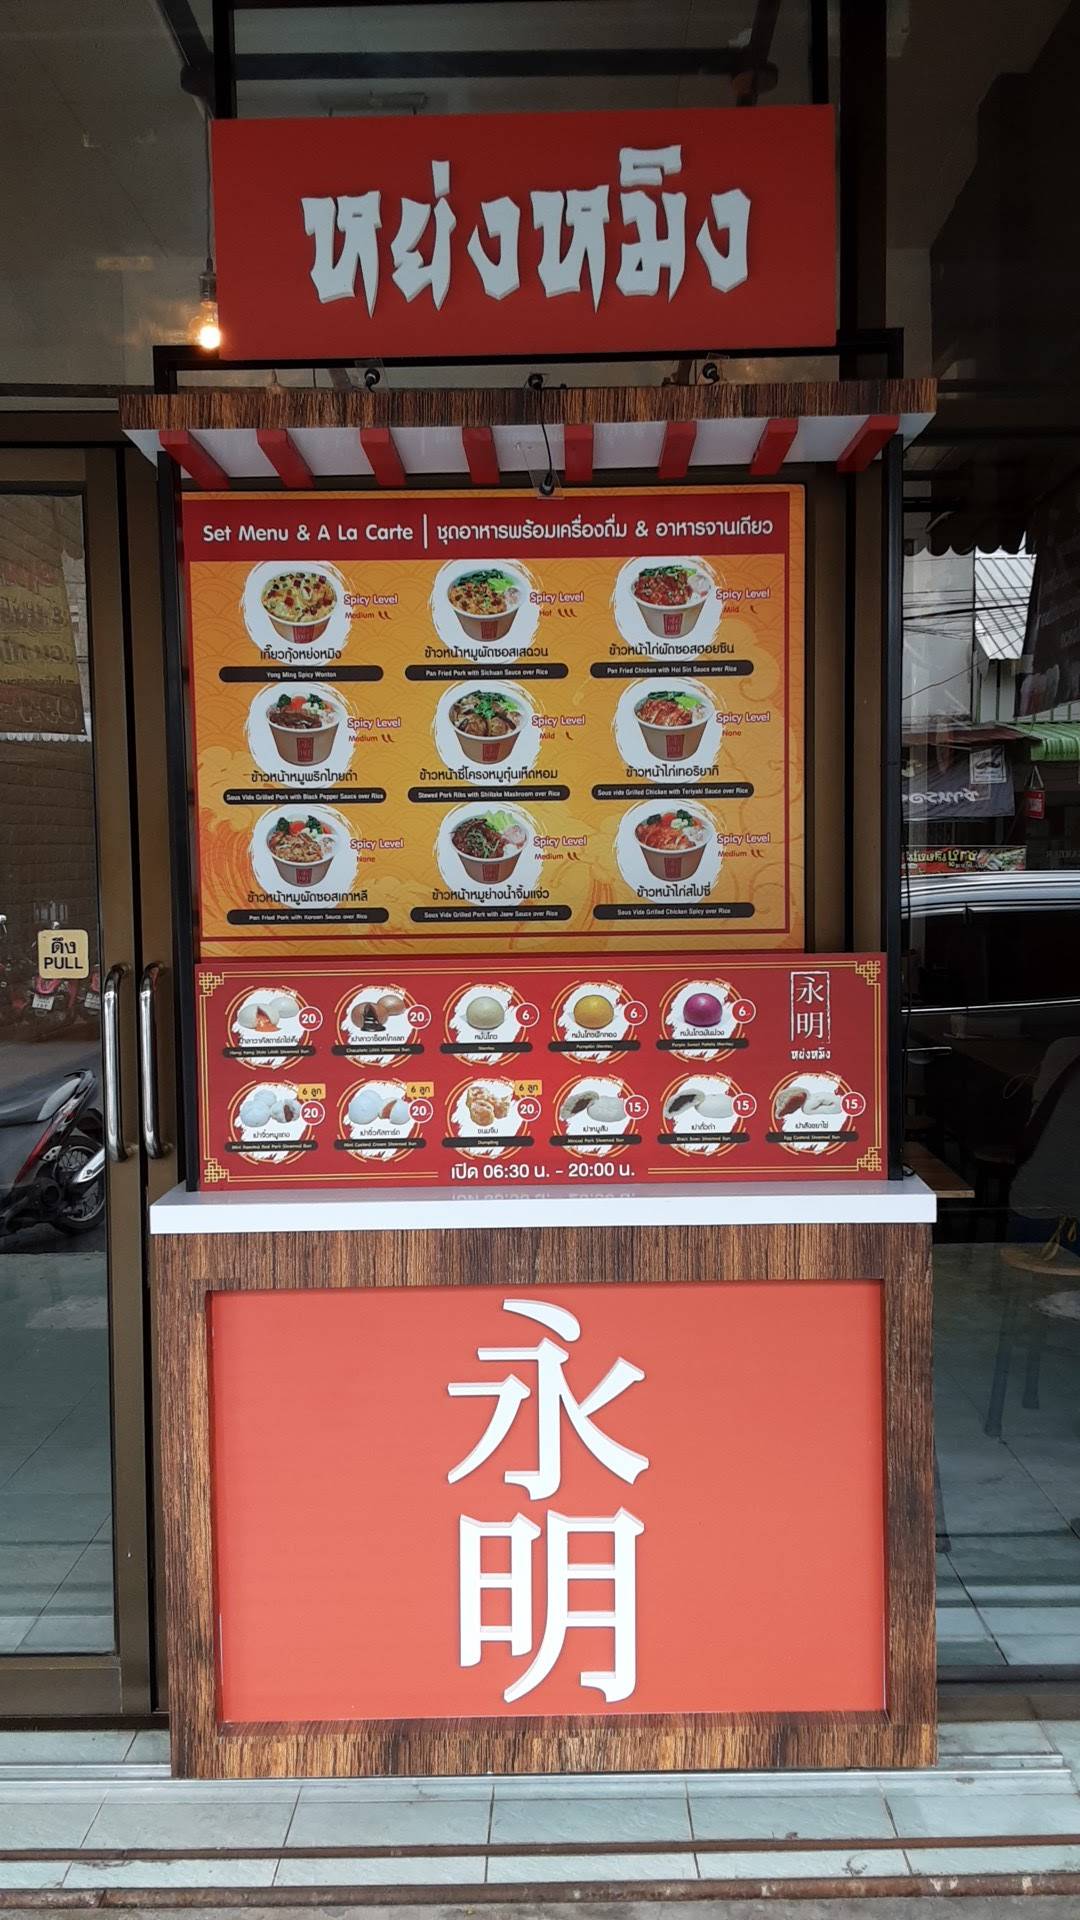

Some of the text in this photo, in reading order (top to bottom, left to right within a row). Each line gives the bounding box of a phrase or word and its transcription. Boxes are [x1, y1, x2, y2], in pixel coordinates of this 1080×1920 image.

[203, 524, 414, 541] Set Menu & A La Carte
[436, 514, 773, 545] ชุดอาหารพร้อมเครื่องดื่ม & อาหารจานเดียว
[344, 594, 398, 606] Spicy Level
[530, 592, 584, 605] Spicy Level
[716, 588, 770, 601] Spicy Level
[347, 716, 401, 730] Spicy Level
[532, 715, 586, 728] Spicy Level
[716, 712, 770, 725] Spicy Level
[350, 838, 404, 851] Spicy Level
[534, 835, 587, 848] Spicy Level
[717, 833, 771, 845] Spicy Level
[534, 852, 563, 860] Medium
[51, 937, 76, 954] ดึง
[44, 957, 83, 969] PULL
[795, 976, 825, 1039] 永明
[302, 1087, 308, 1096] 6
[411, 1085, 417, 1094] 6
[519, 1084, 525, 1092] 6
[451, 1162, 479, 1179] เปิด
[484, 1164, 530, 1179] 06:30
[534, 1164, 550, 1178] น.
[568, 1162, 615, 1177] 20:00
[619, 1163, 635, 1177] น.
[447, 1296, 650, 1704] 永明
